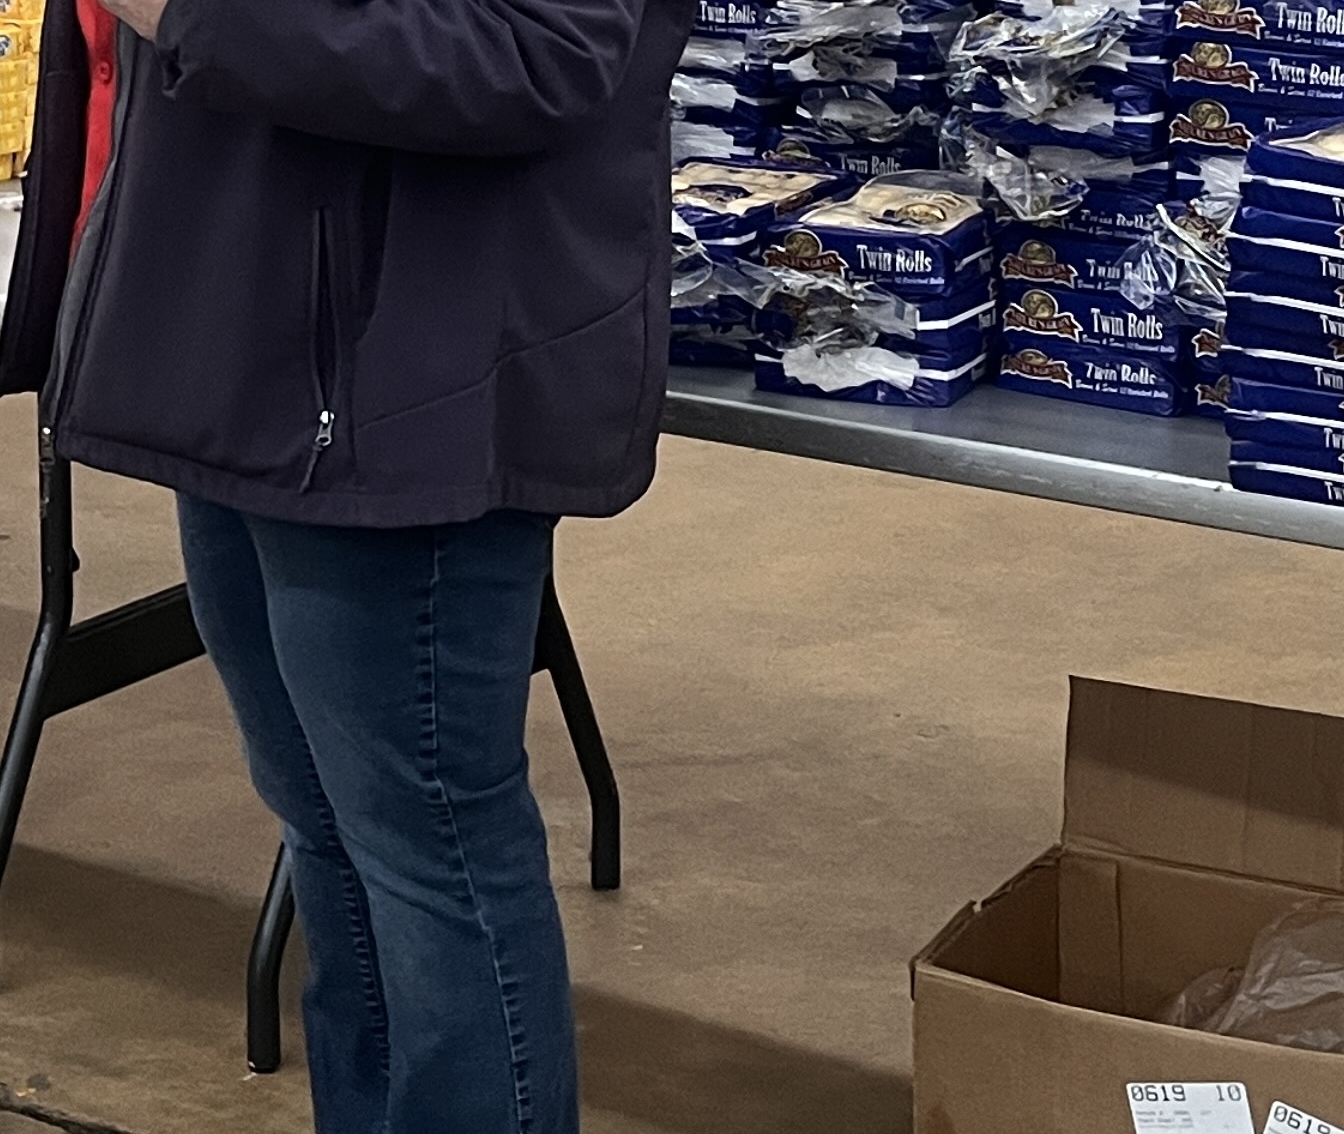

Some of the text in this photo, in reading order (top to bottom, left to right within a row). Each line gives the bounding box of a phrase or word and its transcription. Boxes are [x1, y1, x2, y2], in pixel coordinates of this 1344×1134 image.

[699, 0, 756, 25] Twin Rolls
[1277, 2, 1312, 32] Twin
[1268, 57, 1306, 84] Twin
[857, 244, 932, 273] Twin Rolls
[1091, 307, 1163, 340] Twin Rolls
[1314, 366, 1344, 389] Twin
[1130, 1084, 1242, 1102] 0619 10
